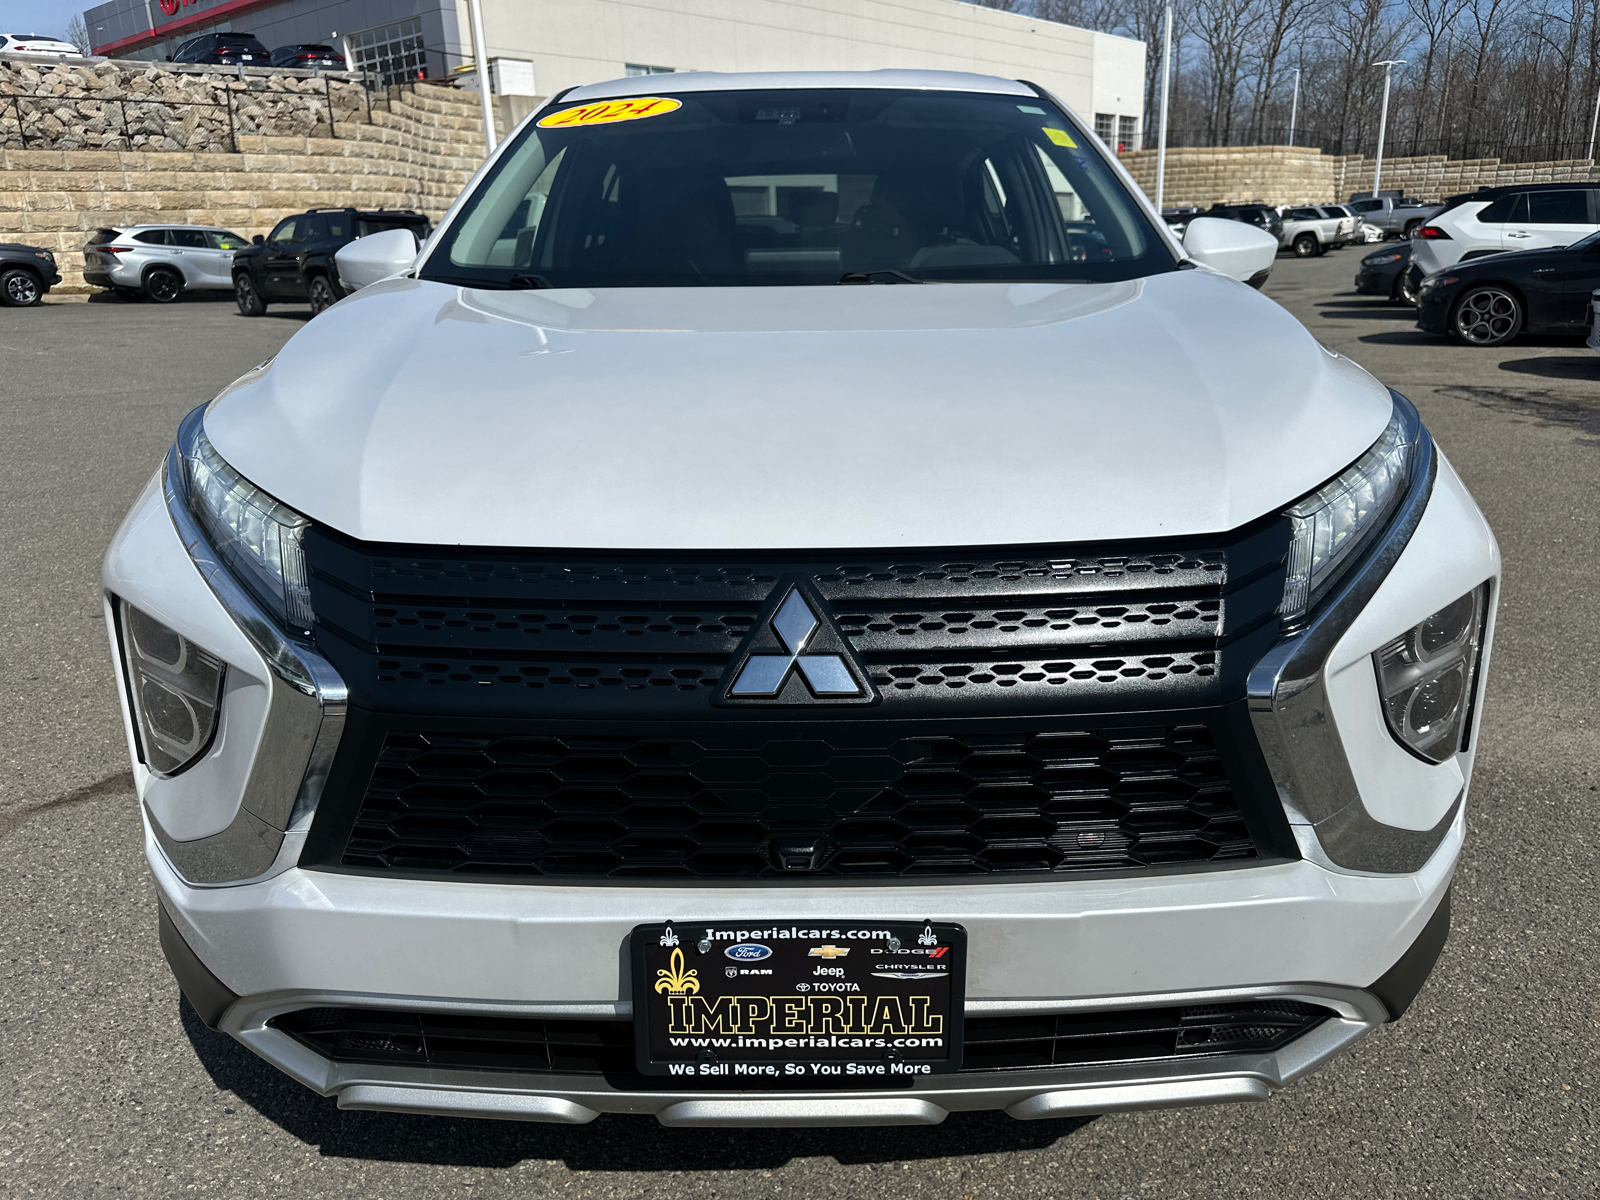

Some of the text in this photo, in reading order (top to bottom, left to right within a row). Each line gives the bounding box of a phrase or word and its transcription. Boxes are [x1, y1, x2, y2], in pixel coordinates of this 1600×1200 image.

[553, 100, 663, 126] 2024
[706, 927, 891, 942] Imperialcars.com
[736, 947, 762, 958] Ford
[813, 966, 844, 977] Jeep
[813, 983, 860, 992] TOYOTA
[668, 996, 943, 1034] IMPERIAL
[669, 1036, 943, 1050] www.imperialcars.com
[669, 1063, 931, 1076] We Sell More, So You Save More
